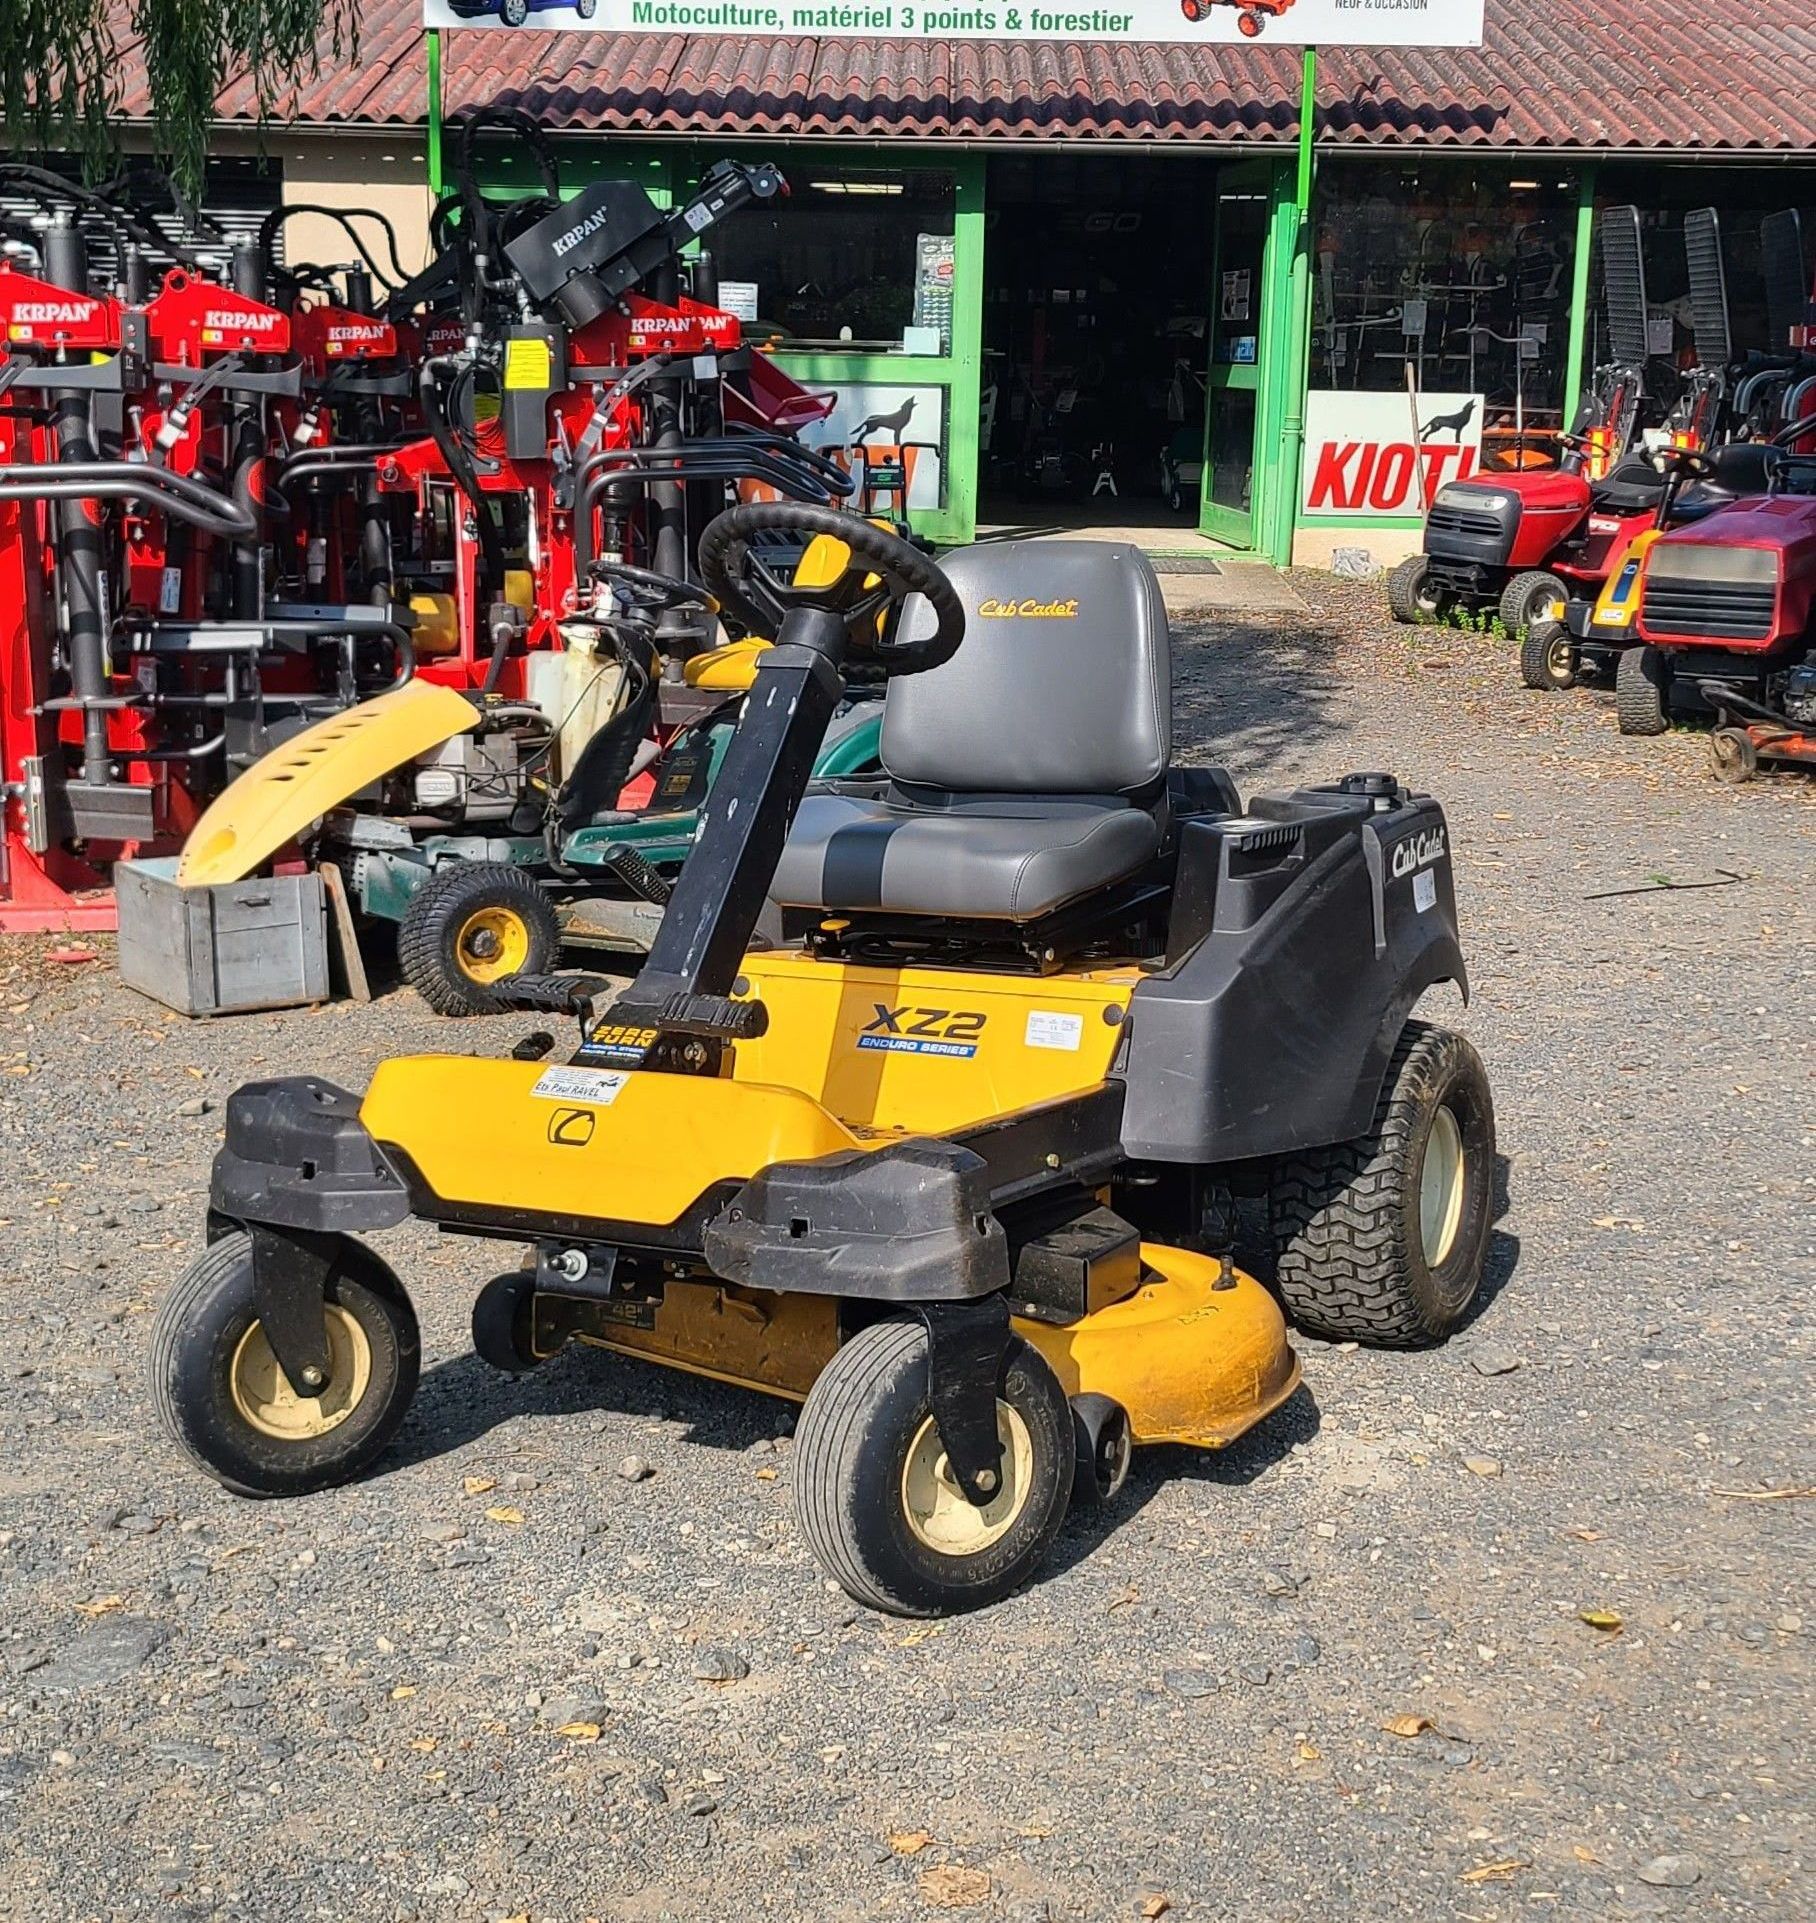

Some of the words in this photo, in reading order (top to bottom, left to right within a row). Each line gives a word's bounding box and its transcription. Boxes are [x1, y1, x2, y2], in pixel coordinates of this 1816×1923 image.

[632, 2, 784, 30] Motoculture,
[793, 6, 892, 28] matériel
[900, 7, 914, 29] 3
[923, 8, 996, 33] points
[1005, 8, 1022, 30] &
[1031, 9, 1133, 32] forestier
[861, 1003, 987, 1040] XZ2
[595, 1026, 658, 1038] ZERO
[592, 1033, 653, 1047] TURN
[860, 1038, 917, 1051] ENDURO
[570, 1086, 600, 1097] RAVEL
